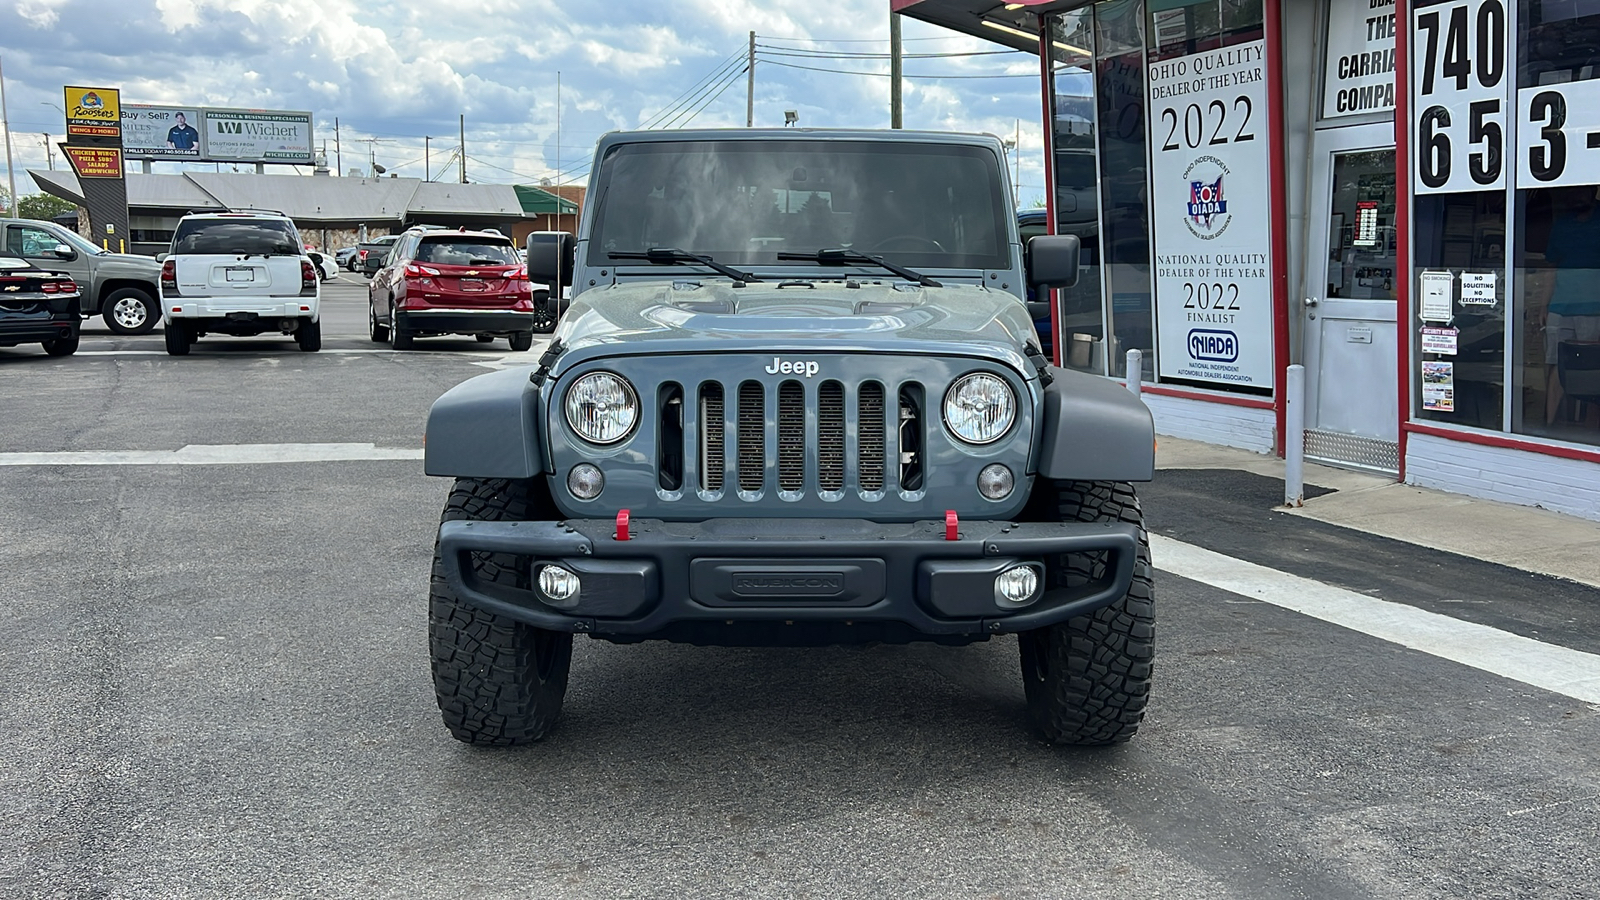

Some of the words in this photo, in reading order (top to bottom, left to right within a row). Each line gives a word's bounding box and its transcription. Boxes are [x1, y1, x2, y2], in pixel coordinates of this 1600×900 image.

[1418, 0, 1505, 95] 740
[1150, 61, 1187, 81] OHIO
[1193, 45, 1264, 75] QUALITY
[1152, 82, 1191, 100] DEALER
[1192, 78, 1206, 92] OF
[1208, 73, 1230, 88] THE
[1232, 67, 1262, 84] YEAR
[72, 106, 114, 118] Roosters
[121, 111, 138, 120] Buy
[148, 112, 170, 120] Sell?
[244, 122, 298, 137] Wichert
[1161, 95, 1255, 151] 2022
[1182, 162, 1195, 180] OHIO
[1194, 155, 1231, 175] INDEPENDENT
[1192, 202, 1220, 215] OIADA
[1157, 254, 1211, 265] NATIONAL
[1215, 253, 1267, 266] QUALITY
[1159, 268, 1195, 278] DEALER
[1198, 268, 1210, 278] OF
[1214, 268, 1234, 278] THE
[1238, 268, 1266, 278] YEAR
[1183, 282, 1241, 311] 2022
[1187, 312, 1235, 324] FINALIST
[765, 357, 820, 378] Jeep
[1189, 362, 1210, 371] NATIONAL
[1209, 364, 1239, 373] INDEPENDENT
[1178, 369, 1203, 378] AUTOMOBILE
[1203, 371, 1222, 380] DEALERS
[1222, 373, 1253, 383] ASSOCIATION
[737, 578, 839, 588] RUBICON
